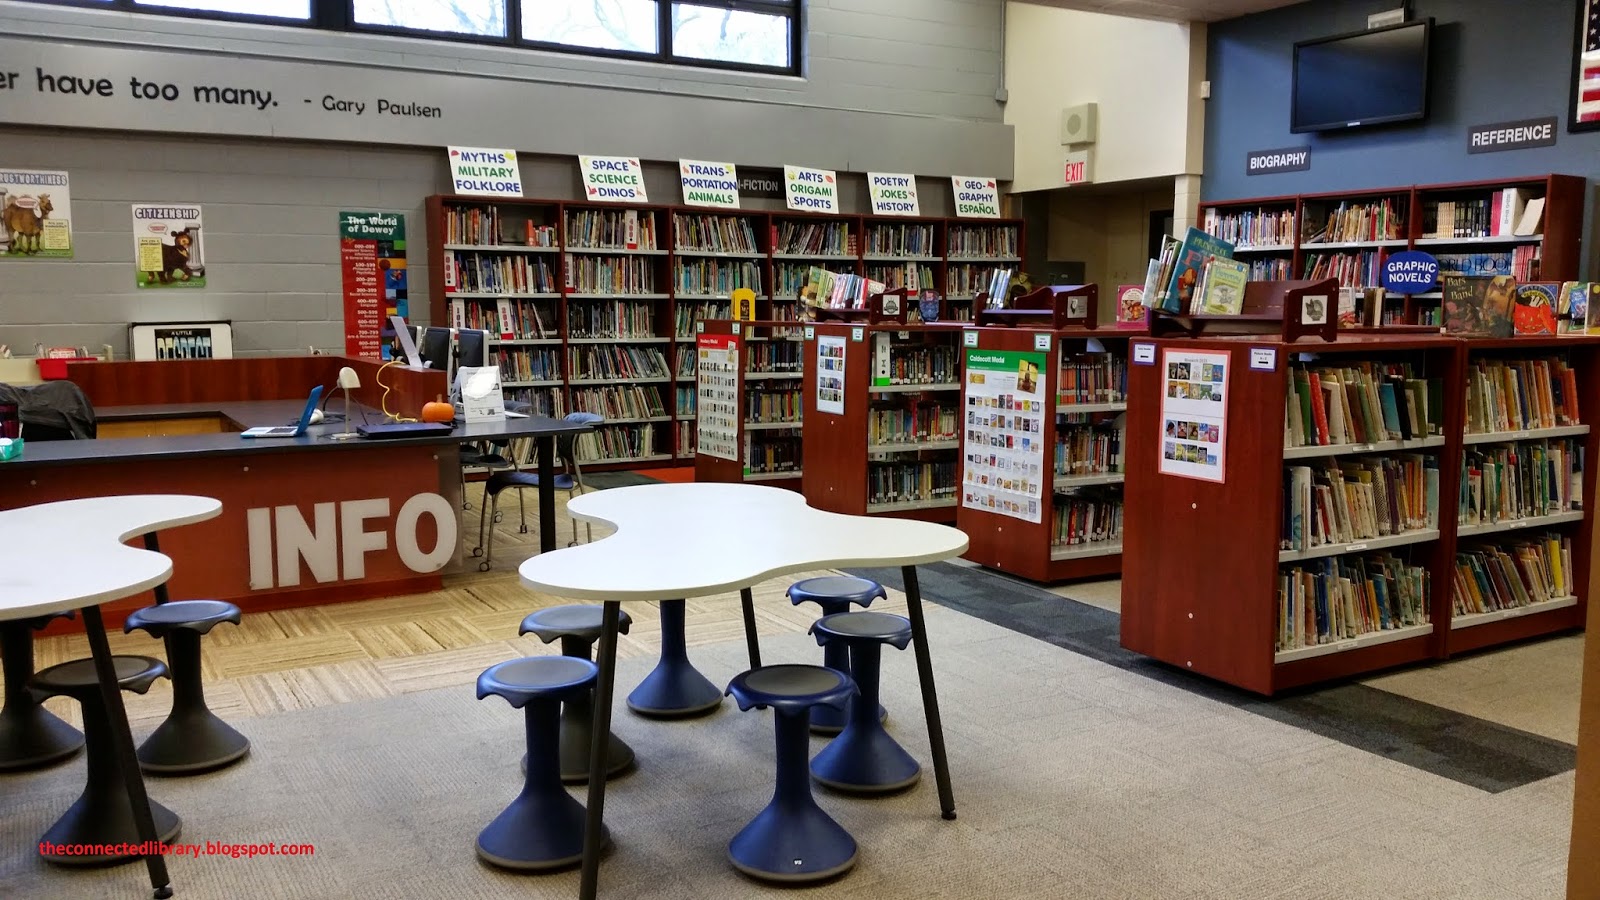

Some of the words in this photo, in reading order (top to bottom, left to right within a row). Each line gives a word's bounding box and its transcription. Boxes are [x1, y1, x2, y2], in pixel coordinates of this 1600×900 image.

[37, 67, 113, 96] have
[130, 76, 179, 101] too
[193, 83, 278, 110] many.
[322, 95, 365, 115] Gary
[378, 98, 442, 118] Paulsen
[1472, 124, 1551, 146] REFERENCE
[461, 152, 505, 163] MYTHS
[1250, 152, 1306, 169] BIOGRAPHY
[458, 165, 513, 177] MILITARY
[592, 160, 628, 171] SPACE
[688, 164, 730, 177] TRANS-
[1065, 161, 1084, 182] EXIT
[589, 173, 638, 185] SCIENCE
[798, 171, 823, 183] ARTS
[873, 176, 909, 187] POETRY
[455, 180, 521, 193] FOLKLORE
[682, 177, 738, 190] PORTATION
[964, 180, 986, 190] GEO-
[598, 187, 635, 198] DINOS
[790, 183, 832, 197] ORIGAMI
[879, 189, 908, 199] JOKES
[688, 191, 734, 204] ANIMALS
[793, 197, 832, 209] SPORTS
[958, 192, 993, 203] GRAPHY
[135, 207, 199, 219] CITIZENSHIP
[876, 202, 915, 212] HISTORY
[958, 203, 996, 216] ESPAÑOL
[347, 216, 366, 225] The
[368, 216, 397, 226] World
[362, 225, 394, 235] Dewey
[1388, 261, 1437, 273] GRAPHIC
[1389, 273, 1431, 284] NOVELS
[1447, 277, 1466, 286] Bats
[1450, 285, 1473, 300] Band
[970, 354, 991, 363] Caldecott
[247, 492, 457, 590] INFO
